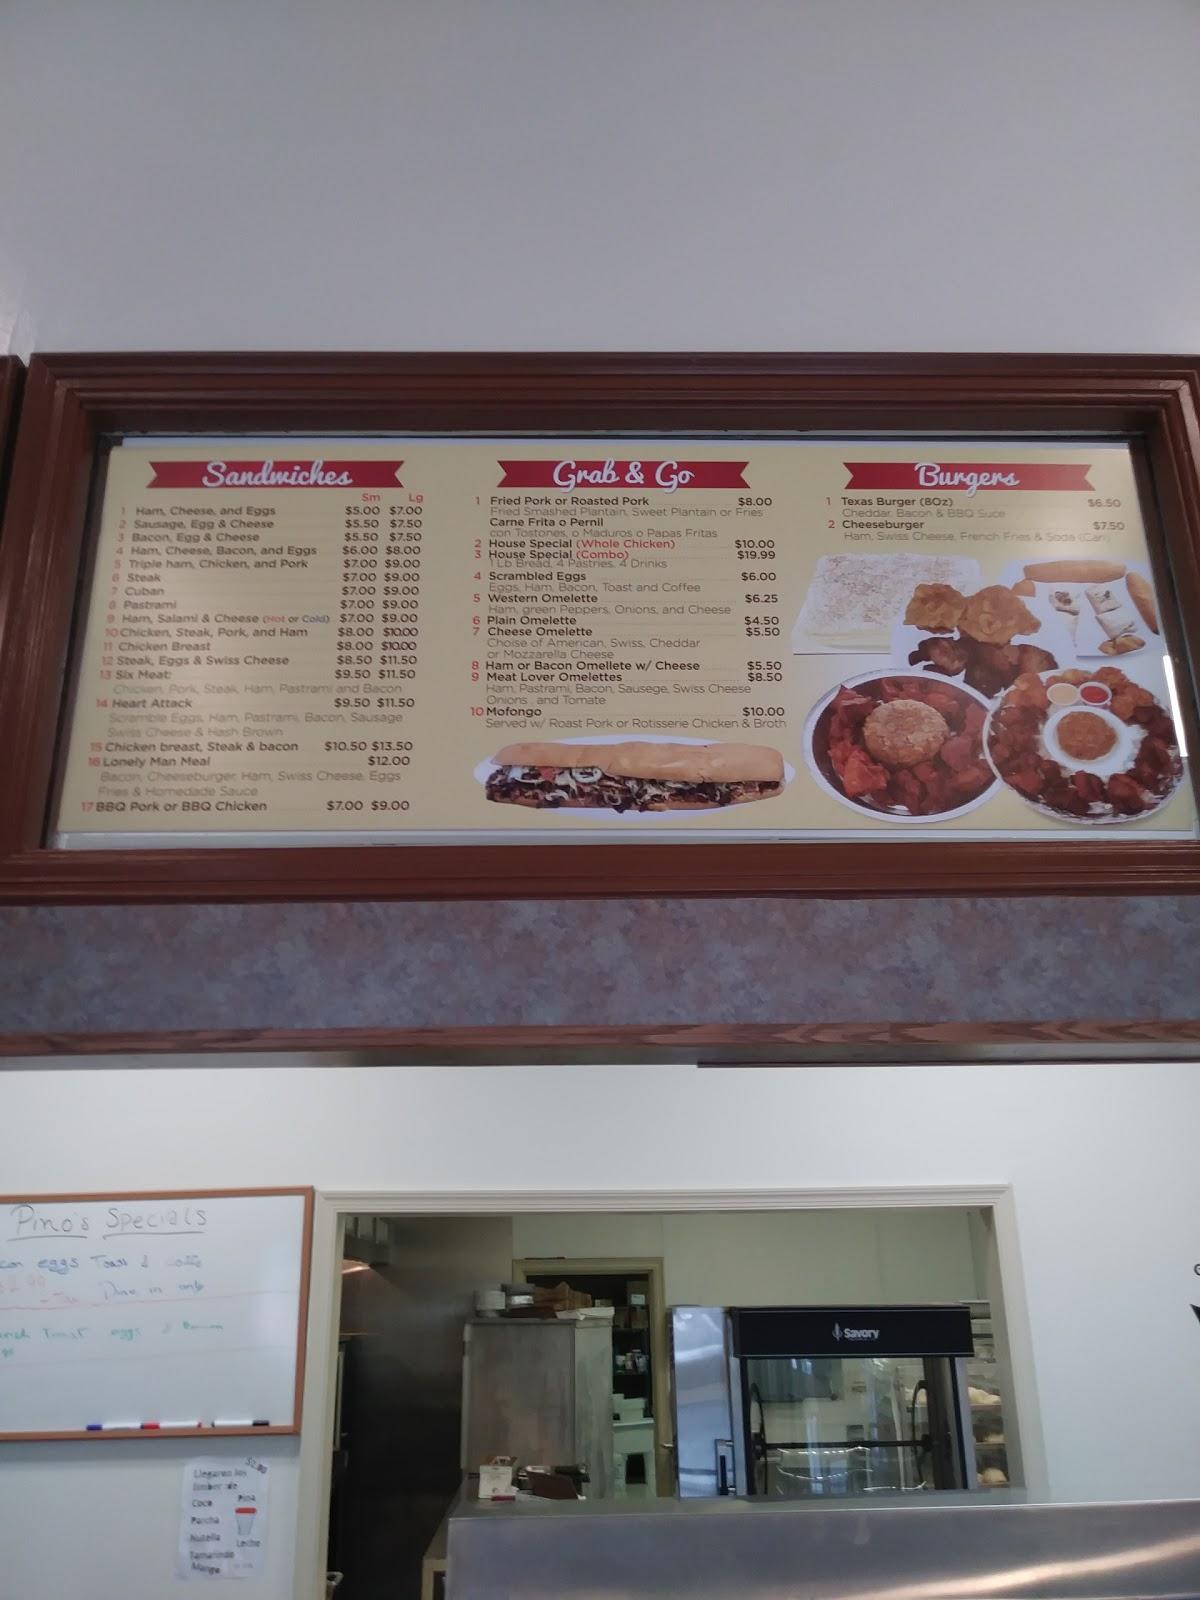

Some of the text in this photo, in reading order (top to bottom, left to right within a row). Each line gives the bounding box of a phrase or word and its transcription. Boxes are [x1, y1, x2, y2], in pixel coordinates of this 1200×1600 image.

[202, 460, 353, 488] Sandwiches
[553, 458, 695, 493] Grab & Go
[914, 462, 1020, 497] Burgers
[362, 493, 423, 504] Sm Lg
[490, 497, 521, 505] Fried
[525, 497, 551, 505] Pork
[571, 497, 618, 505] Roasted
[622, 497, 649, 505] Pork
[738, 497, 772, 507] $8.00
[841, 497, 873, 506] Texas
[877, 497, 915, 508] Burger
[1088, 498, 1121, 508] $6.50
[136, 505, 422, 517] Ham, Cheese, and Eggs $5.00 $7.00
[134, 518, 422, 530] Sausage, Egg & Cheese $5.50 $7.50
[490, 518, 524, 527] Carne
[528, 518, 556, 527] Frita
[570, 518, 604, 527] Pernil
[828, 520, 1125, 531] 2 Cheeseburger $7.50
[344, 532, 422, 543] $5.50 $7.50
[515, 528, 568, 539] Tostones,
[584, 528, 633, 537] Maduros
[647, 528, 682, 540] Papas
[686, 528, 718, 537] Fritas
[474, 540, 775, 549] 2 House Special (Whole Chicken) $10.00
[131, 545, 420, 557] Ham, Cheese, Bacon, and Eggs $6.00 $8.00
[474, 550, 776, 560] 3 House Special (Combo) $19.99
[129, 559, 420, 570] Triple ham, Chicken, and Pork $7.00 $9.00
[127, 572, 420, 583] Steak $7.00 $9.00
[489, 571, 553, 581] Scrambled
[557, 572, 586, 583] Eggs
[741, 572, 776, 582] $6.00
[342, 585, 419, 596] $7.00 $9.00
[489, 583, 701, 594] Eggs, Ham, Bacon, Toast and Coffee
[340, 599, 418, 610] $7.00 $9.00
[473, 594, 778, 604] 5 Western Omelette $6.25
[489, 605, 731, 617] Ham, green Peppers, Onions, and Cheese
[340, 613, 417, 624] $7.00 $9.00
[473, 616, 780, 626] 6 Plain Omelette $4.50
[472, 627, 781, 637] 7 Cheese Omelette $5.50
[117, 654, 417, 666] Steak, Eggs & Swiss Cheese $8.50 $11.50
[472, 661, 782, 672] 8 Ham or Bacon Omellete w/ Cheese $5.50
[335, 669, 416, 680] $9.50 $11.50
[472, 672, 783, 683] 9 Meat Lover Omelettes $8.50
[334, 697, 415, 708] $9.50 $11.50
[471, 707, 785, 718] 10 Mofongo $10.00
[324, 740, 413, 752] $10.50 $13.50
[368, 755, 410, 767] $12.00
[96, 800, 410, 812] BBQ Pork or BBQ Chicken $7.00 $9.00
[106, 1207, 207, 1230] Specials
[844, 1328, 880, 1340] Savory
